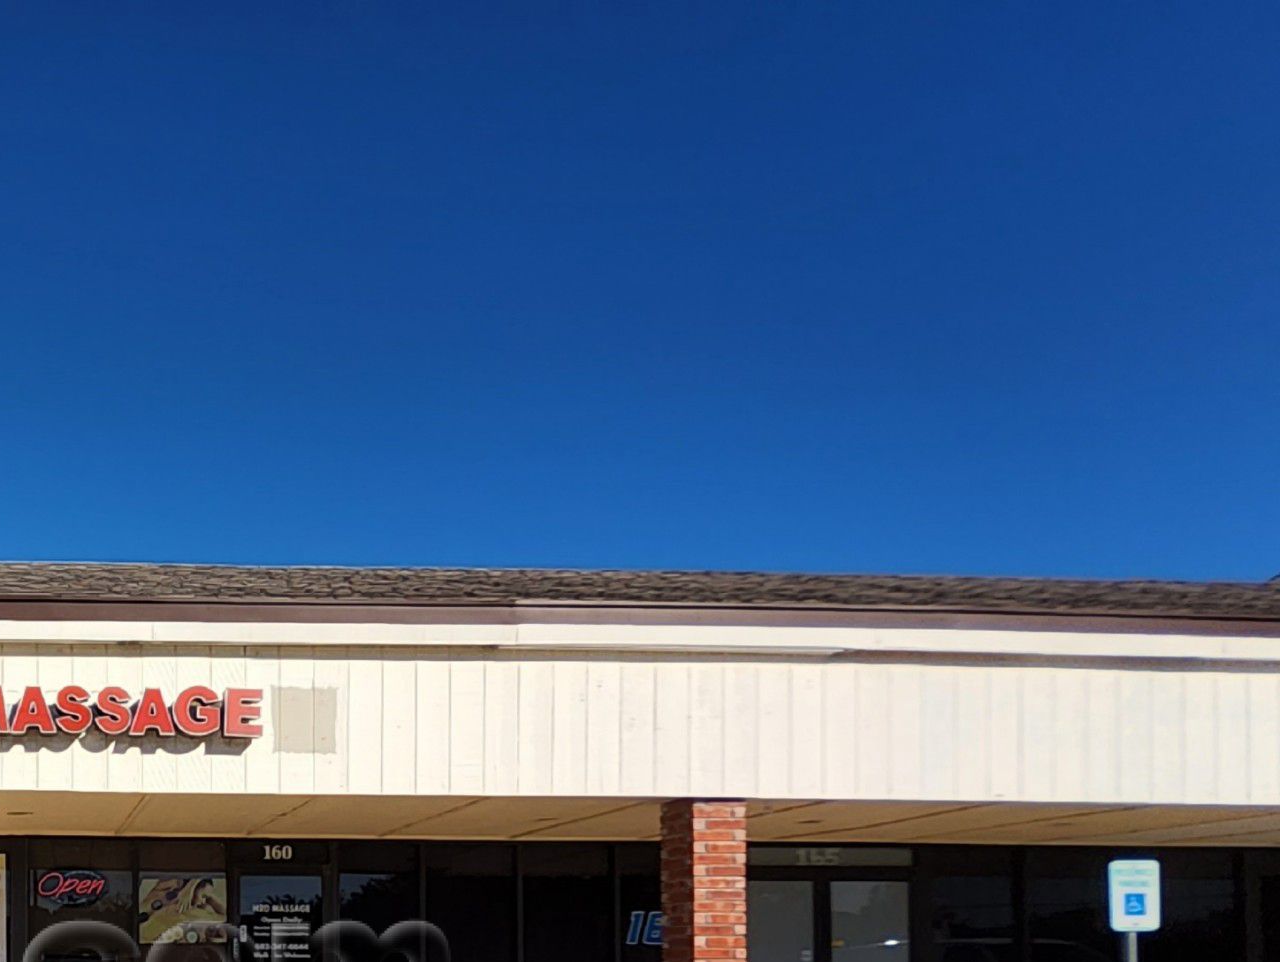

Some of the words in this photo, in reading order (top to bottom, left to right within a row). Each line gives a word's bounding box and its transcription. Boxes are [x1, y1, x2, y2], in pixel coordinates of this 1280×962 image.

[262, 844, 293, 860] 160
[37, 871, 106, 899] Open
[271, 904, 311, 913] MASSAGE
